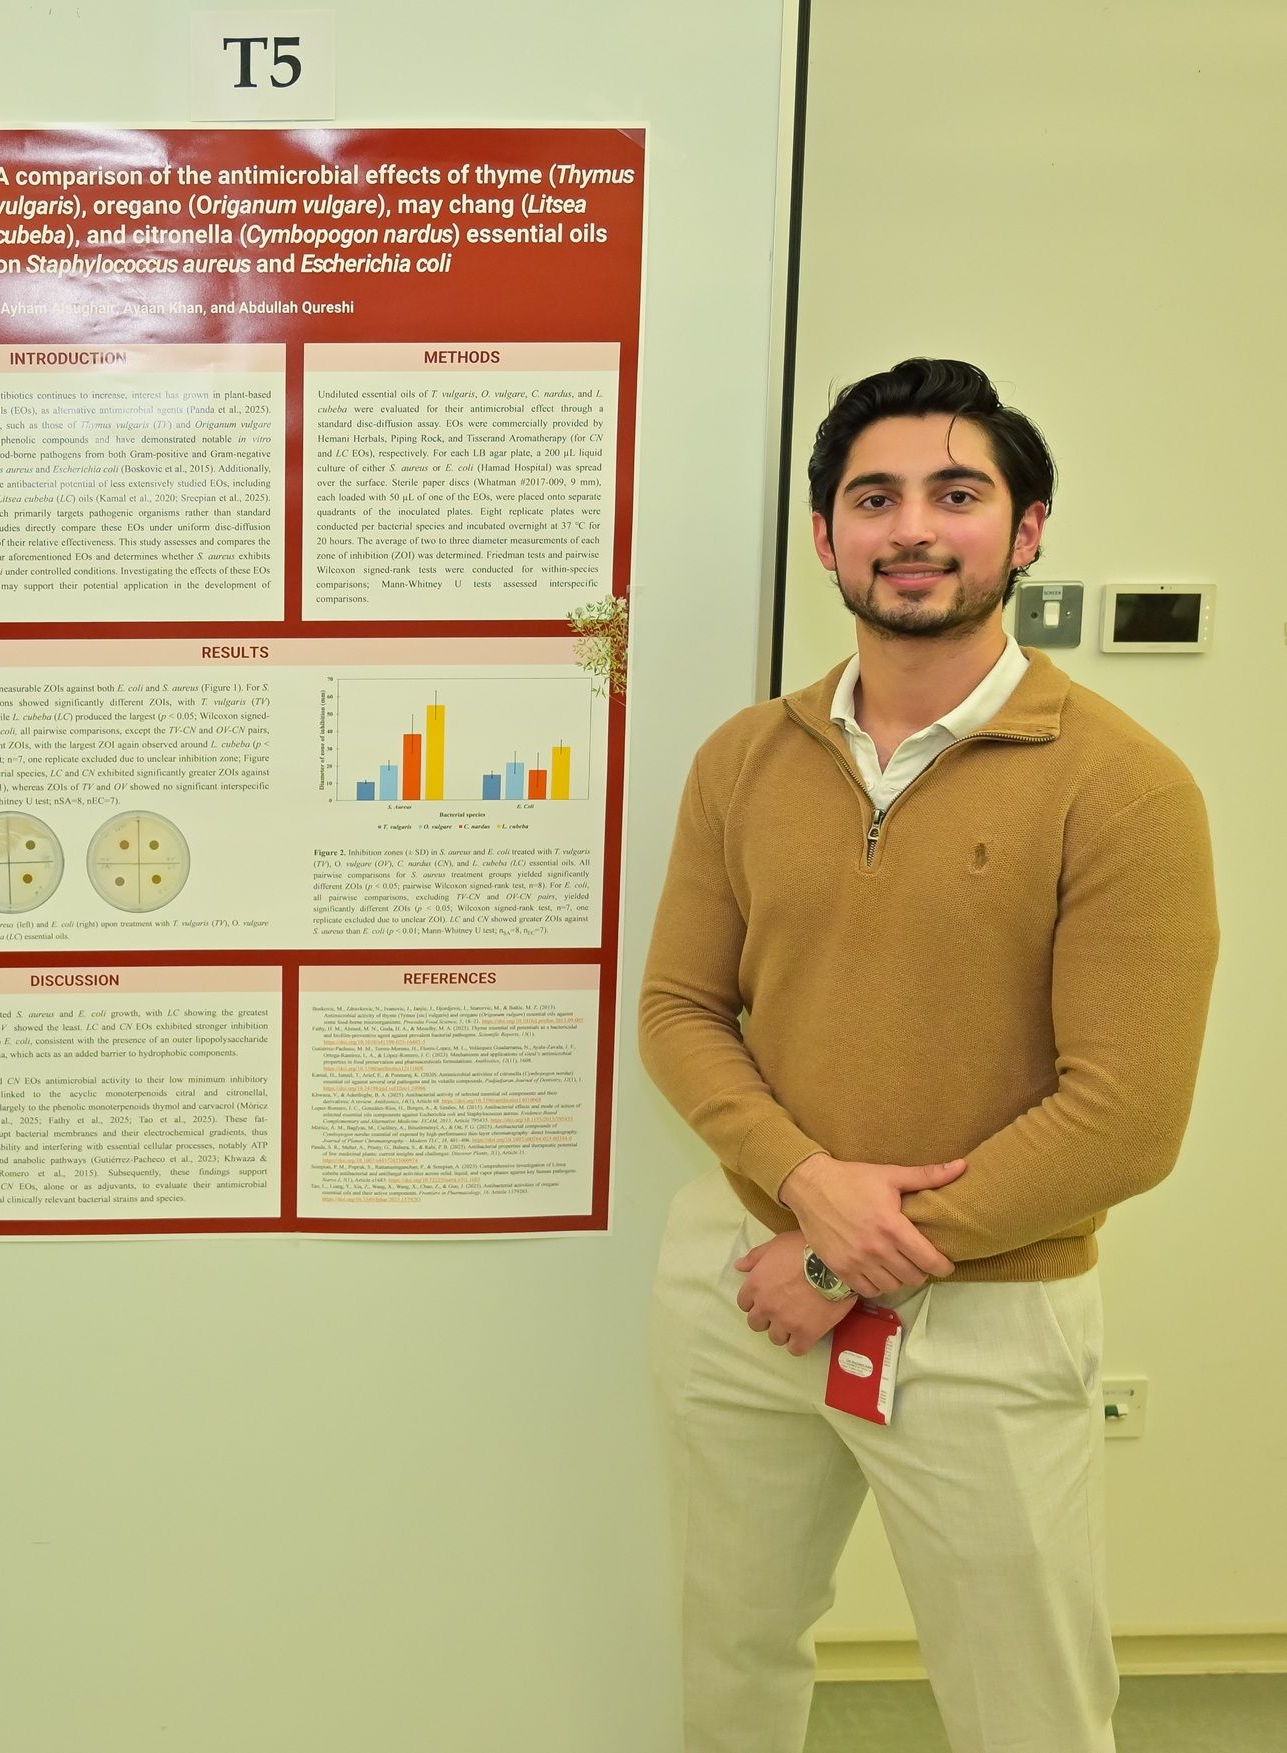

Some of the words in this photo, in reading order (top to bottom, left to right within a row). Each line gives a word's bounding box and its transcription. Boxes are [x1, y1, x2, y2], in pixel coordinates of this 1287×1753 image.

[223, 36, 301, 88] T5
[15, 166, 142, 190] comparison
[149, 165, 173, 185] of
[177, 165, 211, 185] the
[218, 164, 358, 184] antimicrobial
[365, 163, 441, 184] effects
[447, 163, 470, 184] of
[475, 164, 542, 189] thyme
[549, 163, 635, 188] (Thymus
[93, 200, 181, 219] oregano
[189, 194, 297, 219] (Origanum
[303, 193, 391, 219] vulgare),
[398, 199, 443, 219] may
[449, 194, 514, 218] chang
[521, 193, 586, 218] (Litsea
[87, 224, 129, 247] and
[133, 223, 232, 244] citronella
[240, 222, 378, 248] (Cymbopogon
[383, 222, 459, 248] nardus)
[467, 223, 563, 243] essential
[569, 223, 607, 243] oils
[26, 253, 179, 277] Staphylococcus
[183, 258, 251, 273] aureus
[256, 253, 295, 273] and
[301, 253, 411, 273] Escherichia
[416, 252, 452, 272] coli
[0, 301, 47, 318] Ayham
[123, 301, 165, 318] Ayaan
[169, 301, 207, 317] Khan,
[210, 300, 235, 314] and
[239, 300, 298, 314] Abdullah
[302, 300, 353, 314] Qureshi
[10, 351, 126, 365] INTRODUCTION
[424, 350, 500, 363] METHODS
[317, 434, 349, 442] Hemani
[353, 434, 387, 443] Herbals,
[391, 434, 417, 444] Piping
[421, 434, 445, 443] Rock,
[448, 434, 463, 442] and
[466, 433, 505, 442] Tisserand
[509, 433, 567, 444] Aromatherapy
[570, 433, 586, 443] (for
[589, 433, 603, 442] CN
[40, 450, 81, 461] pathogens
[85, 450, 104, 458] from
[108, 450, 126, 458] both
[129, 449, 188, 460] Gram-positive
[192, 450, 207, 458] and
[210, 449, 271, 460] Gram-negative
[14, 509, 51, 519] primarily
[57, 510, 84, 519] targets
[89, 508, 133, 519] pathogenic
[138, 508, 180, 519] organisms
[185, 508, 209, 516] rather
[213, 508, 231, 516] than
[236, 508, 271, 516] standard
[25, 523, 56, 534] directly
[61, 524, 96, 534] compare
[101, 523, 122, 531] these
[127, 523, 145, 531] EOs
[149, 523, 173, 531] under
[177, 522, 210, 531] uniform
[215, 522, 271, 533] disc-diffusion
[317, 565, 355, 574] Wilcoxon
[363, 565, 411, 576] signed-rank
[472, 565, 513, 573] conducted
[521, 565, 533, 573] for
[541, 564, 599, 575] within-species
[317, 580, 369, 590] comparisons;
[381, 579, 443, 590] Mann-Whitney
[455, 579, 461, 588] U
[503, 580, 537, 588] assessed
[549, 579, 598, 589] interspecific
[202, 646, 269, 658] RESULTS
[19, 698, 49, 706] showed
[54, 698, 104, 709] significantly
[109, 698, 143, 706] different
[149, 698, 172, 707] ZOIs,
[177, 697, 195, 706] with
[201, 698, 208, 706] T.
[213, 697, 246, 708] vulgaris
[251, 697, 270, 707] (TV)
[313, 871, 342, 880] pairwise
[347, 871, 390, 880] comparisons
[411, 871, 417, 879] S.
[517, 870, 542, 879] yielded
[547, 870, 589, 879] significantly
[31, 974, 119, 986] DISCUSSION
[403, 972, 496, 984] REFERENCES
[1, 1090, 25, 1098] linked
[49, 1090, 61, 1098] the
[69, 1090, 97, 1100] acyclic
[105, 1089, 167, 1099] monoterpenoids
[175, 1088, 195, 1097] citral
[203, 1088, 218, 1096] and
[226, 1088, 268, 1097] citronellal,
[7, 1195, 43, 1205] clinically
[45, 1196, 75, 1204] relevant
[77, 1195, 111, 1203] bacterial
[140, 1194, 154, 1202] and
[156, 1194, 185, 1204] species.
